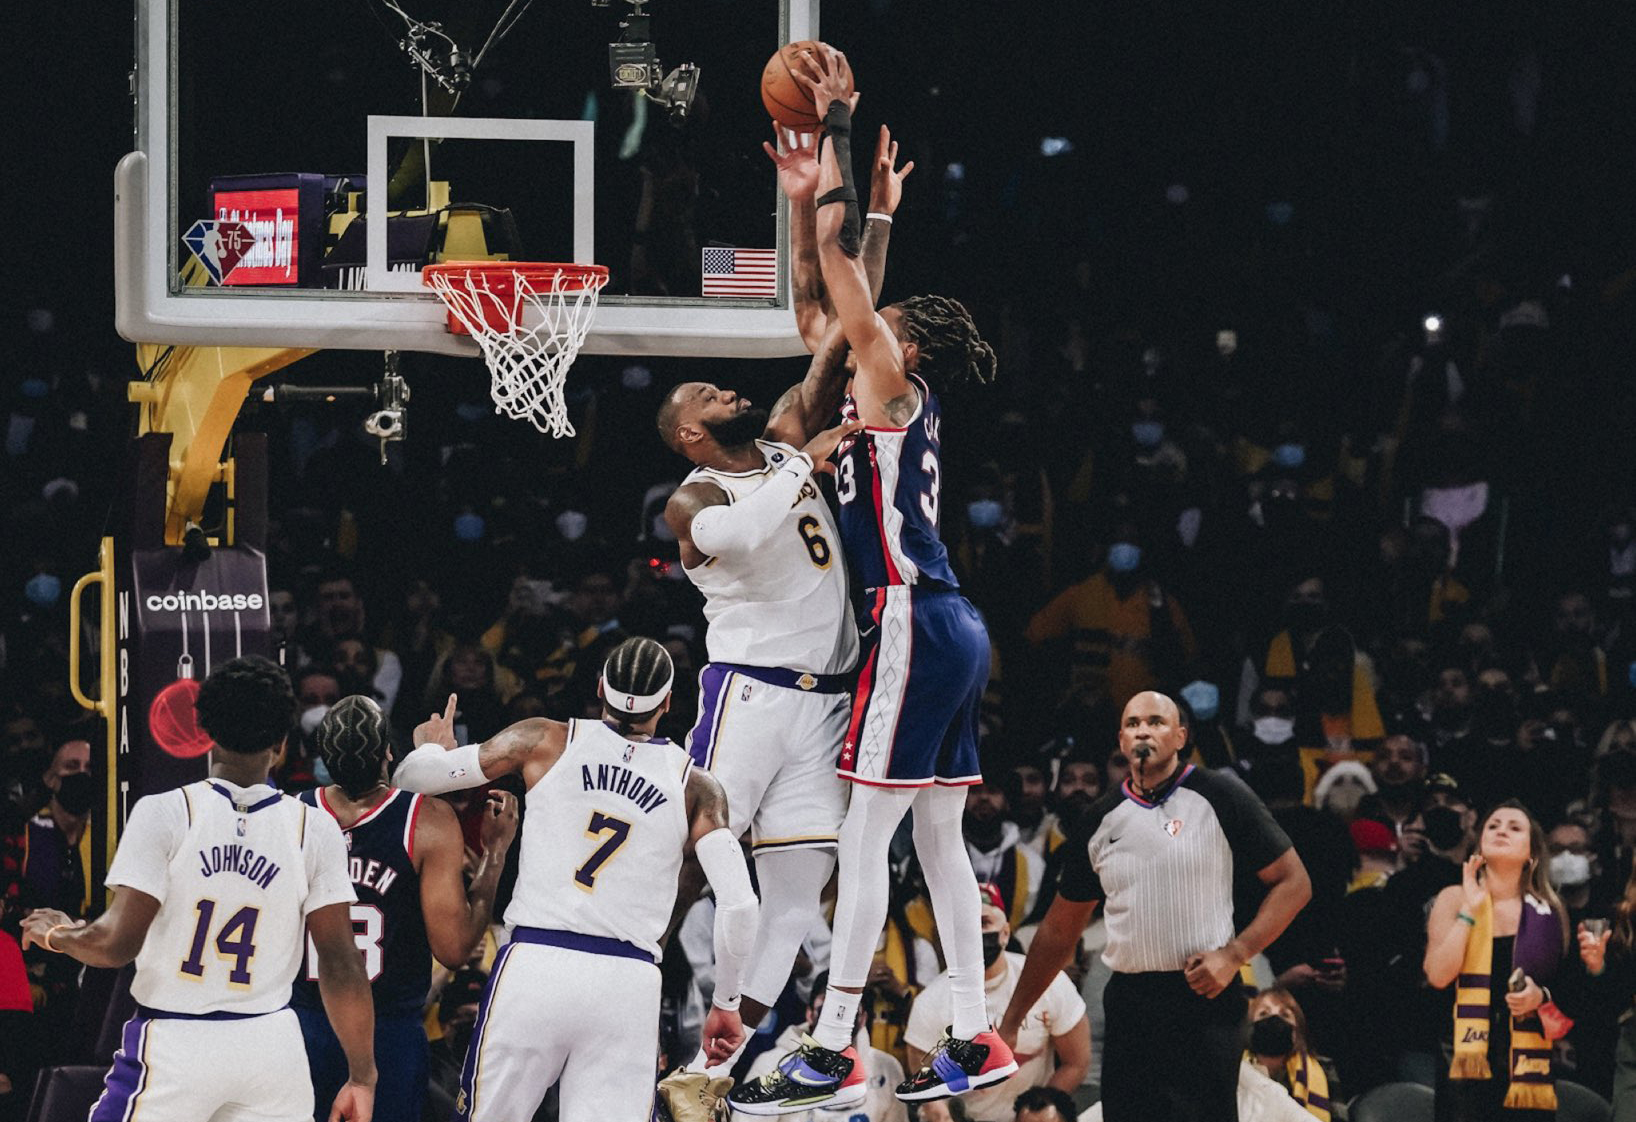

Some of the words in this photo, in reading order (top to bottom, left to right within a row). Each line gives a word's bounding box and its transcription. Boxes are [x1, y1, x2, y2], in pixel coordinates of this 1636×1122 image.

[227, 230, 241, 250] 75
[797, 515, 832, 571] 6
[146, 589, 263, 611] coinbase
[581, 763, 668, 815] ANTHONY
[199, 843, 281, 890] JOHNSON
[573, 809, 633, 893] 7
[349, 856, 399, 896] DEN
[179, 898, 261, 990] 14
